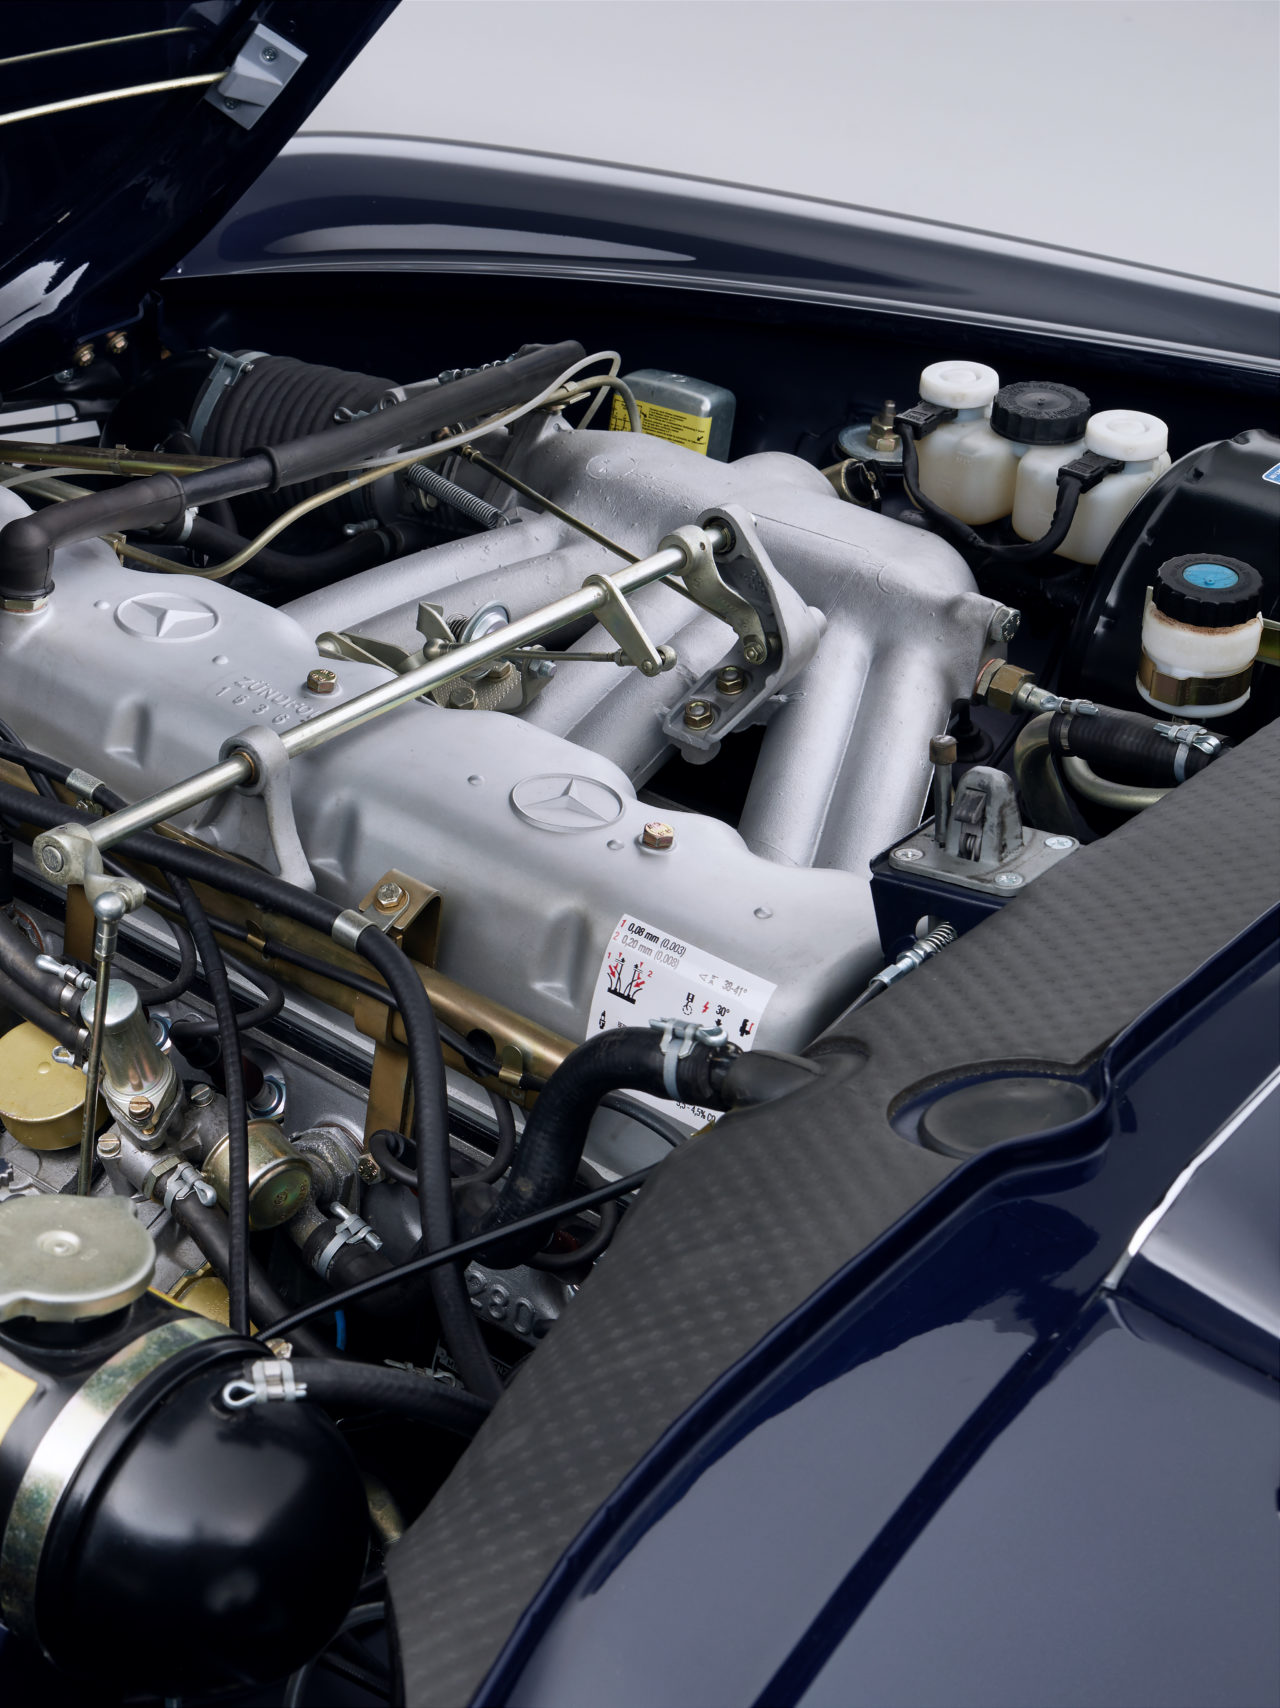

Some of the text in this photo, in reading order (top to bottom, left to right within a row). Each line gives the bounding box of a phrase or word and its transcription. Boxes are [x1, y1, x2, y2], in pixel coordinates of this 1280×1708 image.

[613, 931, 620, 941] 2
[621, 935, 638, 950] 0,20
[638, 943, 653, 956] mm
[620, 919, 687, 958] 1 0,08 mm (0,003)
[467, 1270, 536, 1334] 280
